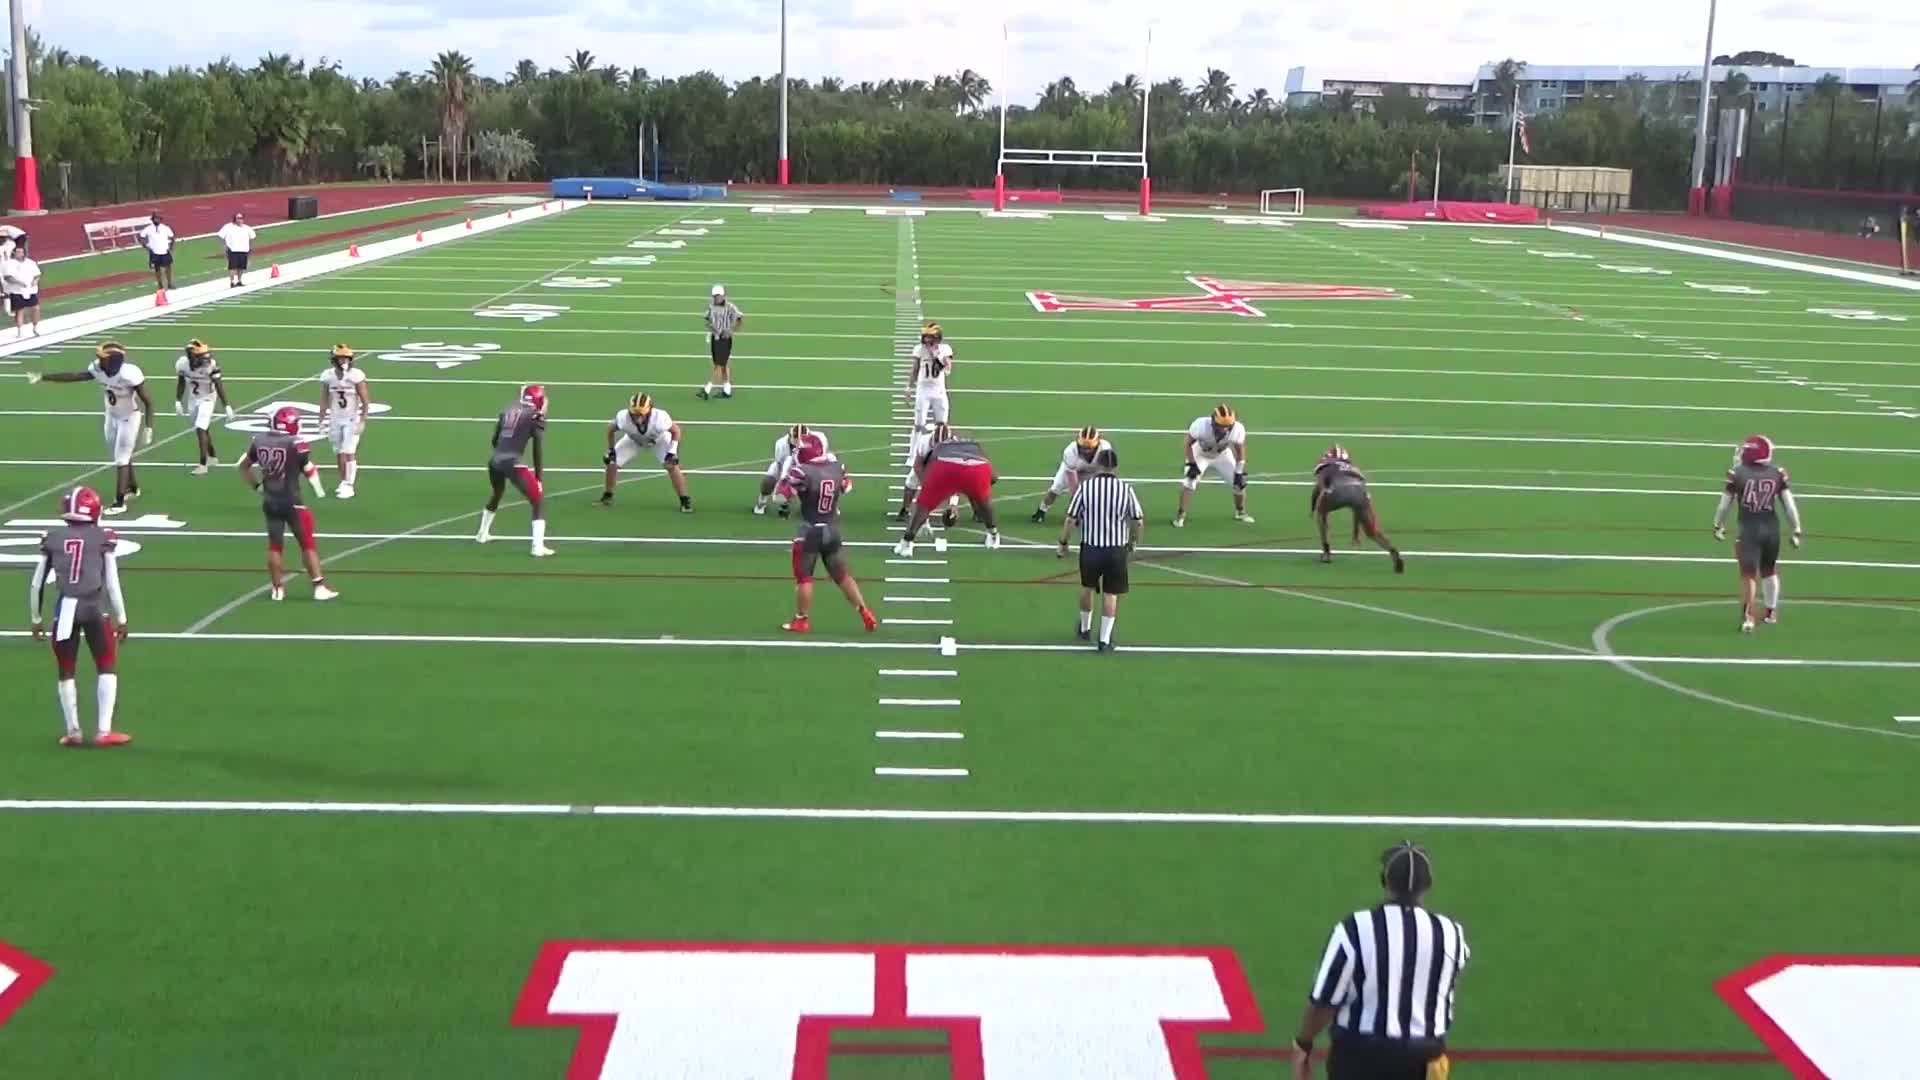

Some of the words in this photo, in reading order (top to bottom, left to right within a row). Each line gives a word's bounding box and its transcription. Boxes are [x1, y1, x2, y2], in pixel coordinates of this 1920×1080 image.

[191, 381, 201, 395] 2
[338, 390, 348, 409] 3
[818, 479, 835, 514] 6
[1743, 479, 1776, 512] 42
[64, 539, 85, 584] 7
